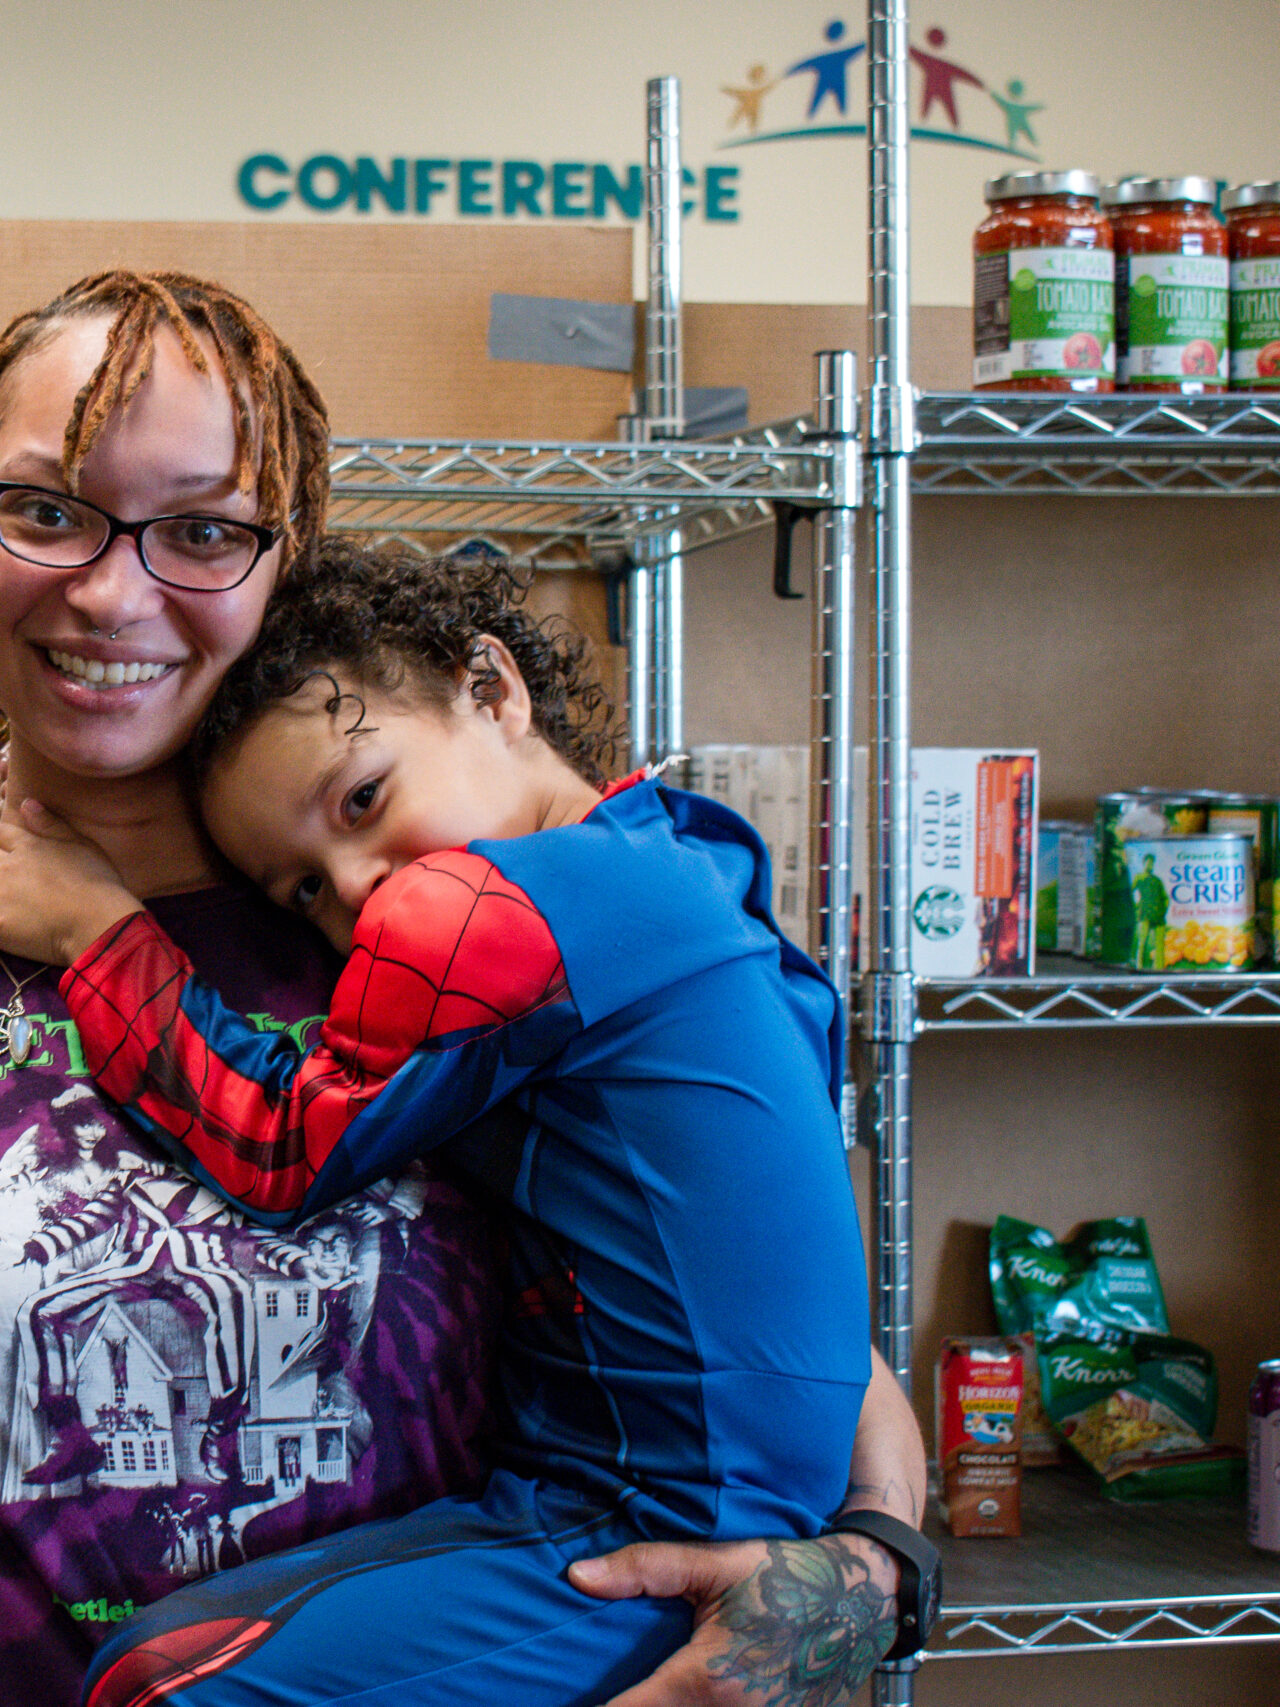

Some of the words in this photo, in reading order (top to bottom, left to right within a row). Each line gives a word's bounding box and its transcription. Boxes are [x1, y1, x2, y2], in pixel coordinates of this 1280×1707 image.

[921, 789, 940, 867] COLD
[942, 787, 962, 870] BREW
[1169, 864, 1246, 883] steam
[1171, 883, 1245, 904] CRISP
[1008, 1256, 1066, 1286] Kno
[1051, 1355, 1136, 1383] Knorr
